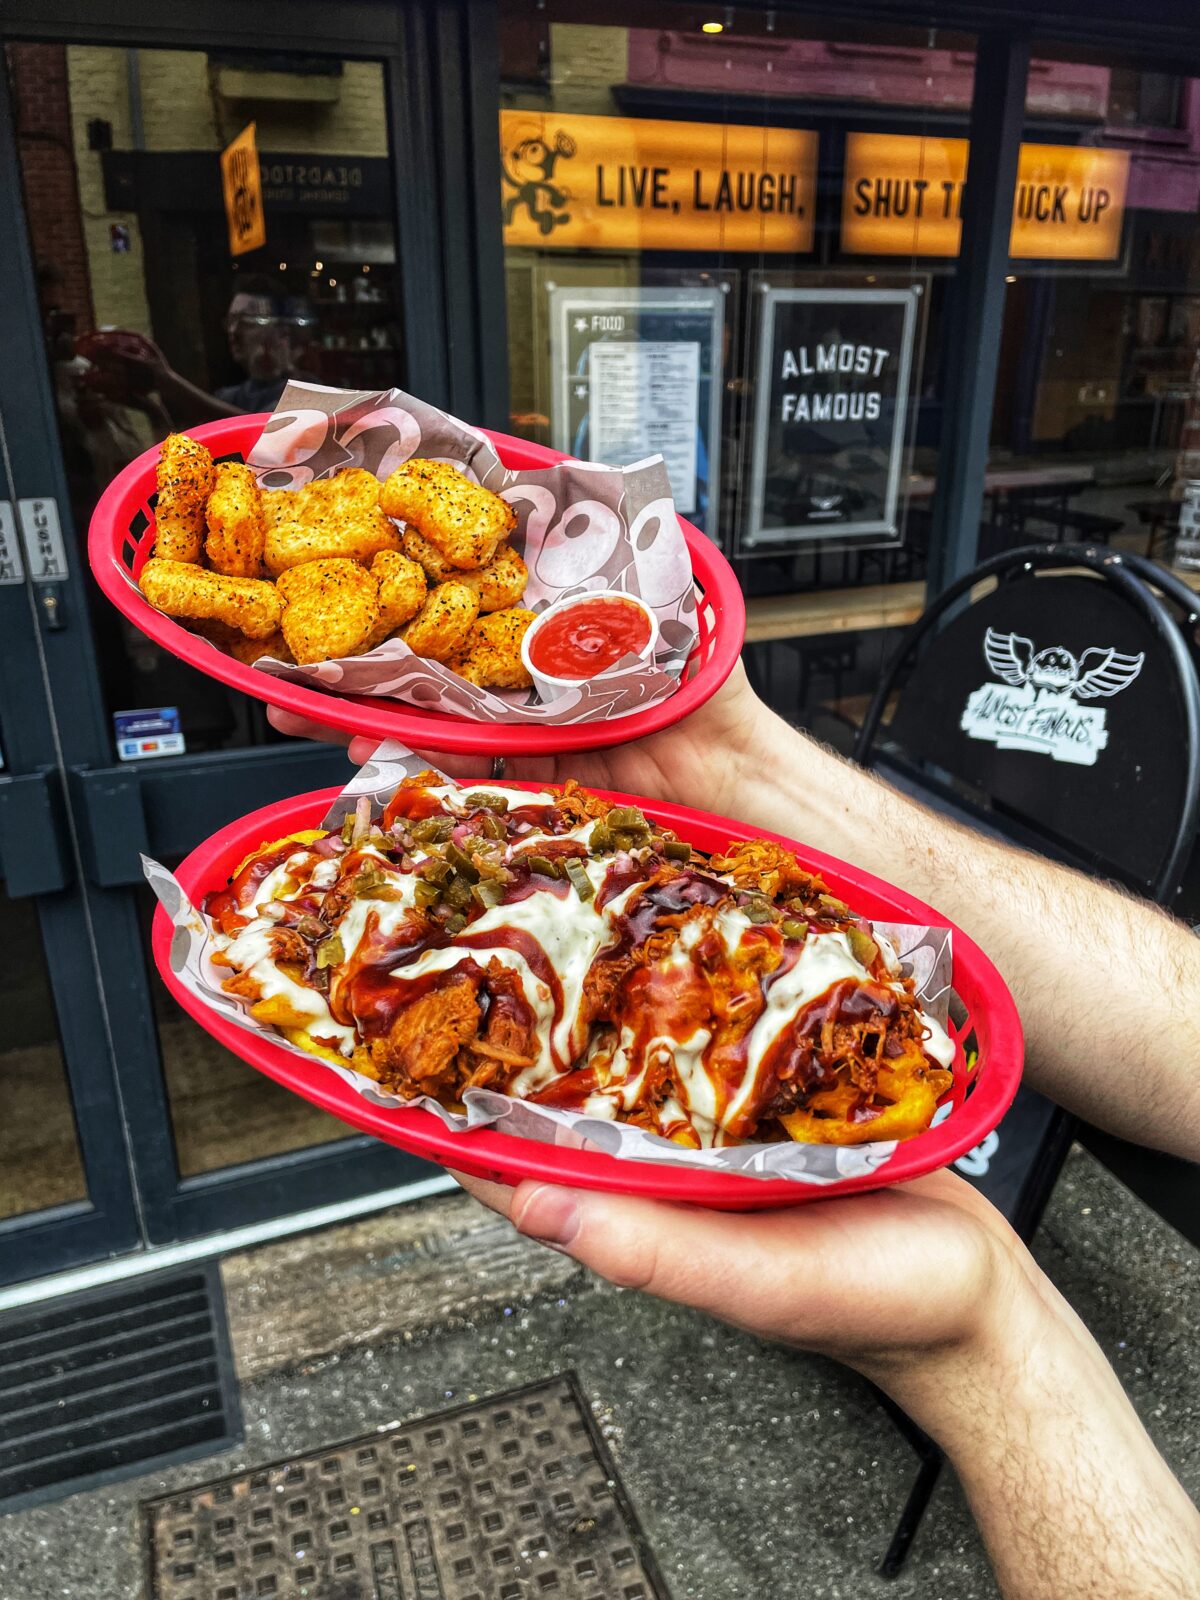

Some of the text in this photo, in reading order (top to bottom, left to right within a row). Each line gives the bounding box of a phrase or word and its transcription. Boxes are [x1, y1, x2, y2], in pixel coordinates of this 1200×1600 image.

[597, 165, 804, 218] LIVE, LAUGH,
[854, 177, 930, 218] SHUT
[1018, 183, 1069, 223] UCK
[1078, 187, 1111, 224] UP
[591, 315, 625, 331] FOOD
[782, 343, 889, 379] ALMOST
[782, 392, 881, 421] FAMOUS
